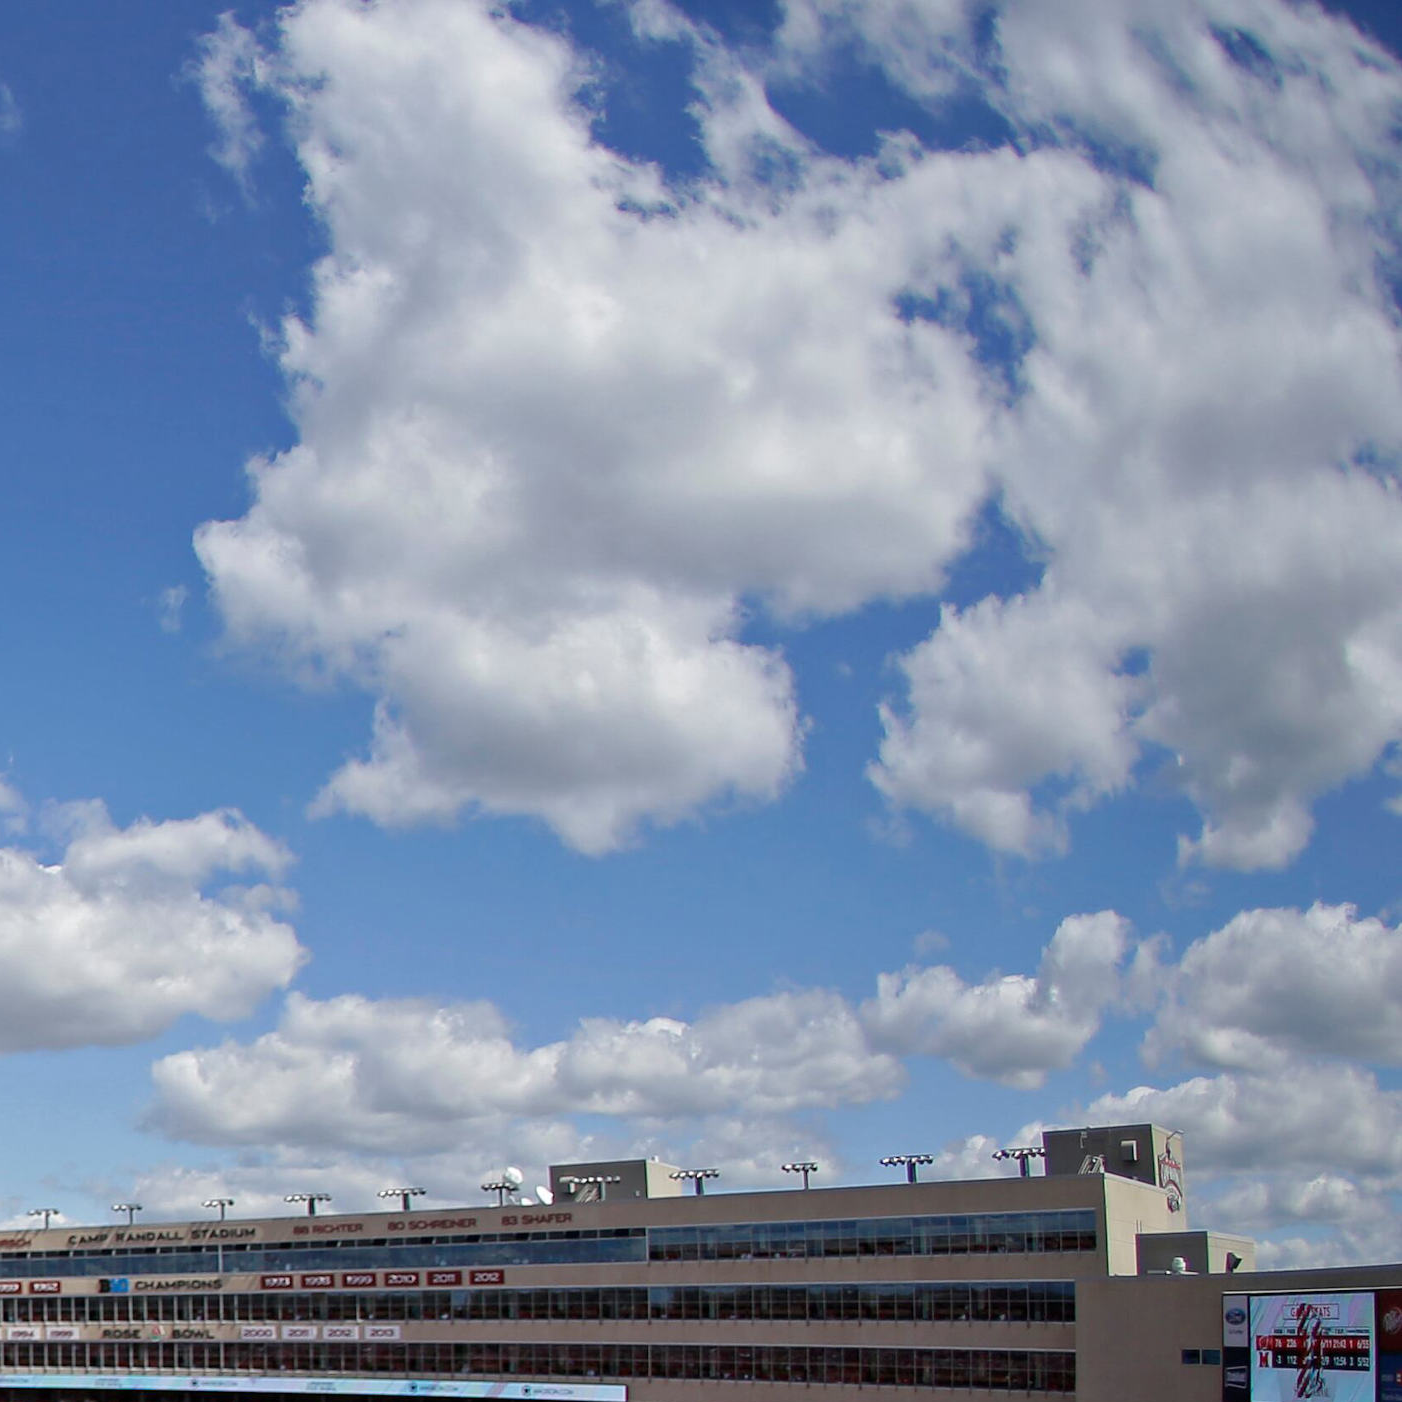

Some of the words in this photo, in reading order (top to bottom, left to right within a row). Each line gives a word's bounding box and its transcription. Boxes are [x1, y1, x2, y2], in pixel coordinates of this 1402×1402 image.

[501, 1216, 520, 1226] 83
[521, 1213, 573, 1225] SHAFER
[312, 1223, 363, 1234] RICHTER
[68, 1233, 108, 1245] CAMP
[115, 1231, 184, 1242] RANDALL
[191, 1228, 256, 1240] STADIUM
[388, 1274, 415, 1284] 2010
[432, 1273, 456, 1283] 2011
[473, 1272, 500, 1282] 2012
[134, 1278, 223, 1291] CHAMPIONS
[102, 1328, 141, 1339] ROSE
[171, 1328, 214, 1339] BOWL
[243, 1329, 273, 1338] 2000
[287, 1328, 310, 1337] 2011
[328, 1328, 352, 1337] 2012
[370, 1328, 395, 1337] 2013
